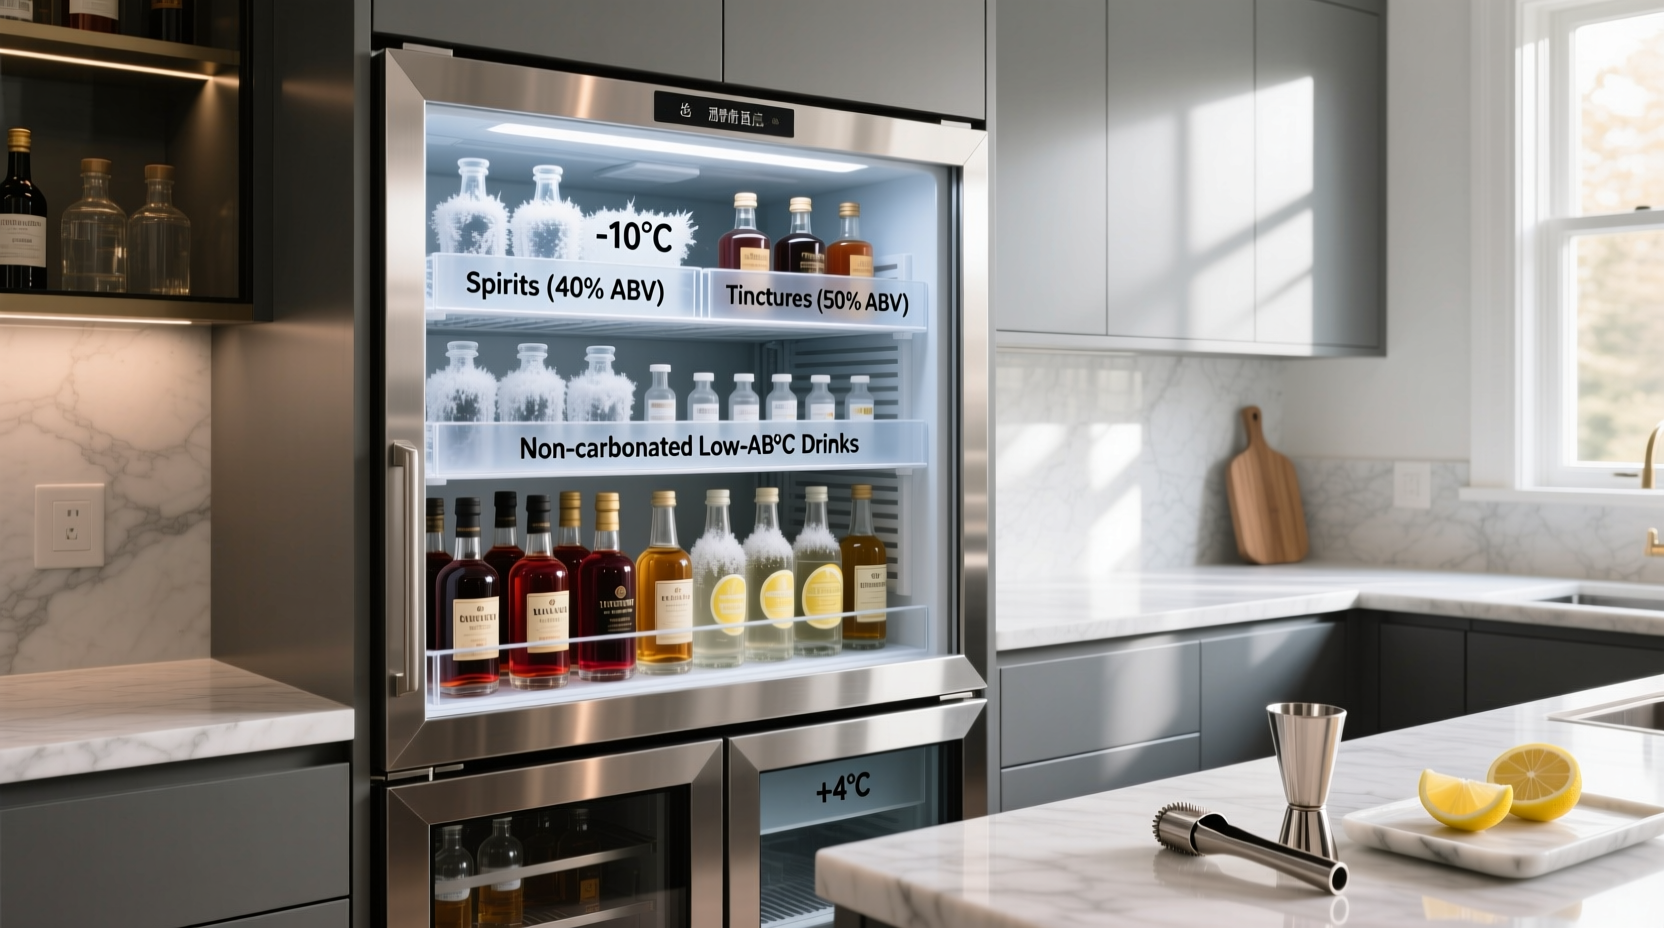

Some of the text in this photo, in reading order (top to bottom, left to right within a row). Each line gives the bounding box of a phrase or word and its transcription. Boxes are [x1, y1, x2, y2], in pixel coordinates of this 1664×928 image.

[596, 221, 672, 253] -10°C
[466, 270, 664, 308] Spirits (40% ABV)
[725, 284, 910, 318] Tinctures (50% ABV)
[520, 434, 693, 460] Non-carbonated
[801, 432, 860, 454] Drinks
[816, 771, 871, 803] +4°C
